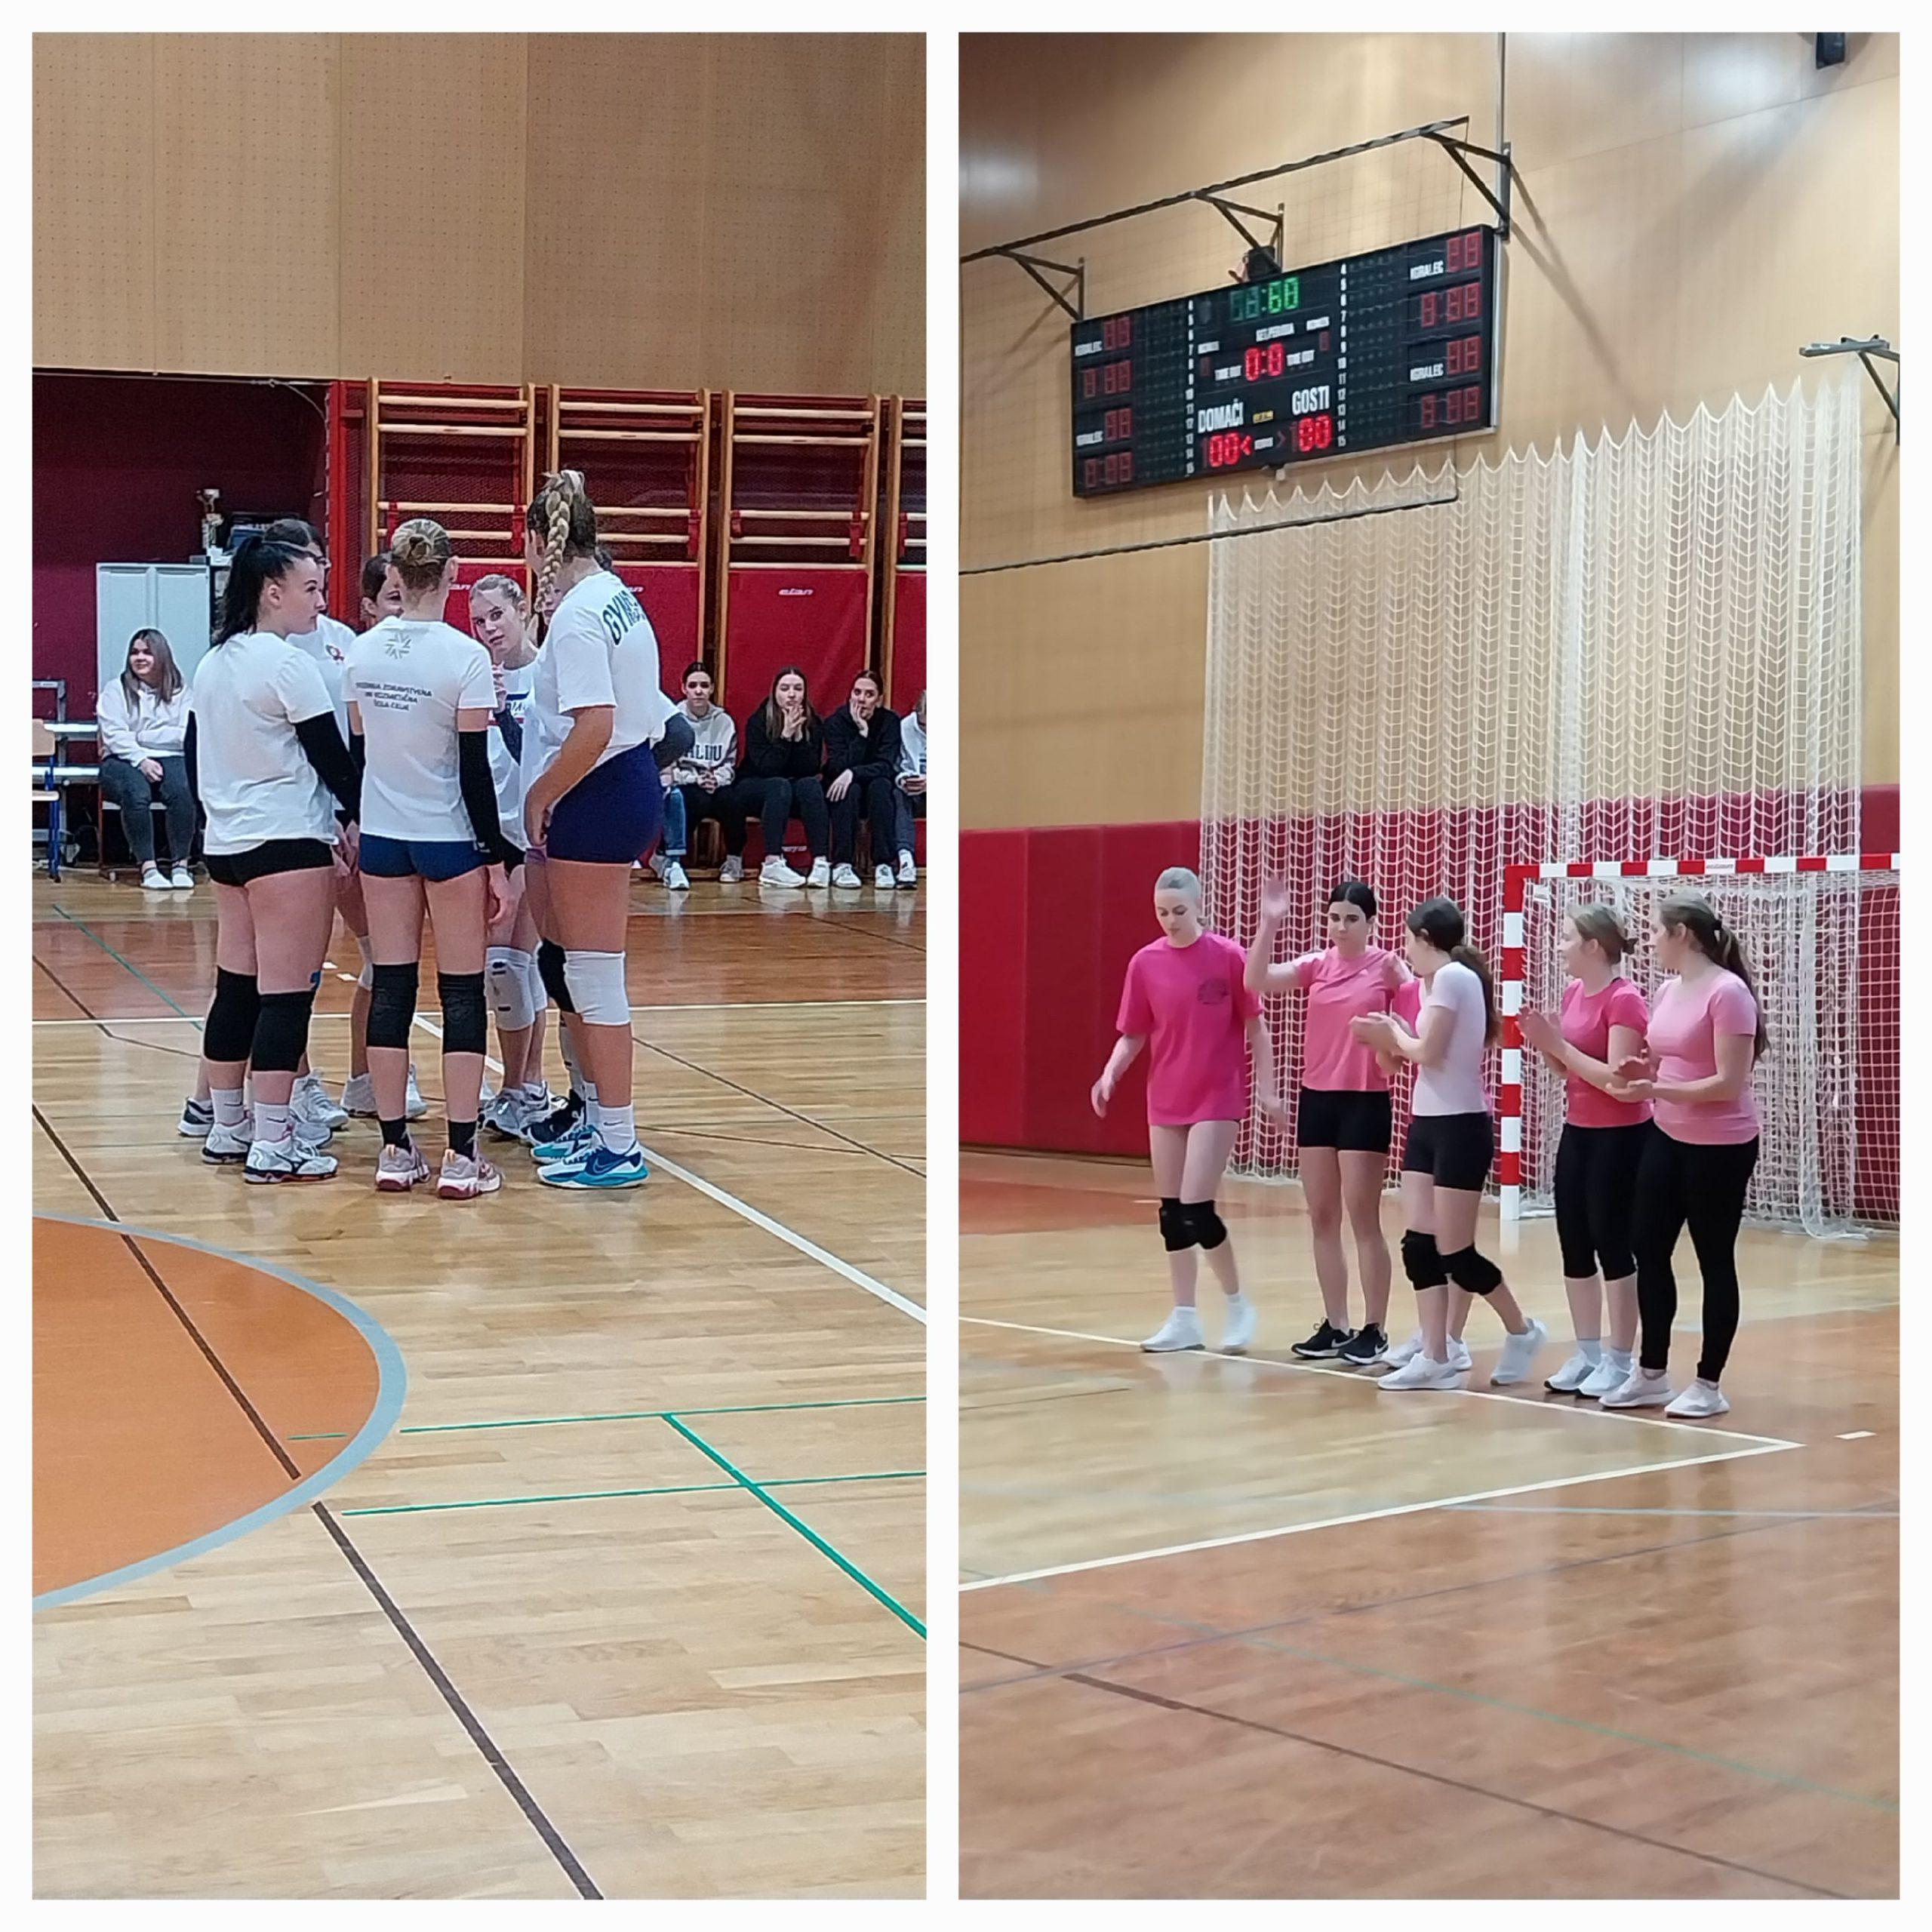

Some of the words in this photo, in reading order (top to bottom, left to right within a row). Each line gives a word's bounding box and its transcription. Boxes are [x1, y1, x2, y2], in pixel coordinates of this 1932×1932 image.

[1340, 278, 1346, 291] 5
[1340, 310, 1346, 322] 7
[1338, 373, 1346, 385] 11
[1292, 385, 1331, 415] GOSTI
[1338, 388, 1346, 401] 12
[1338, 404, 1346, 416] 13
[1338, 419, 1346, 432] 14
[1338, 435, 1346, 447] 15
